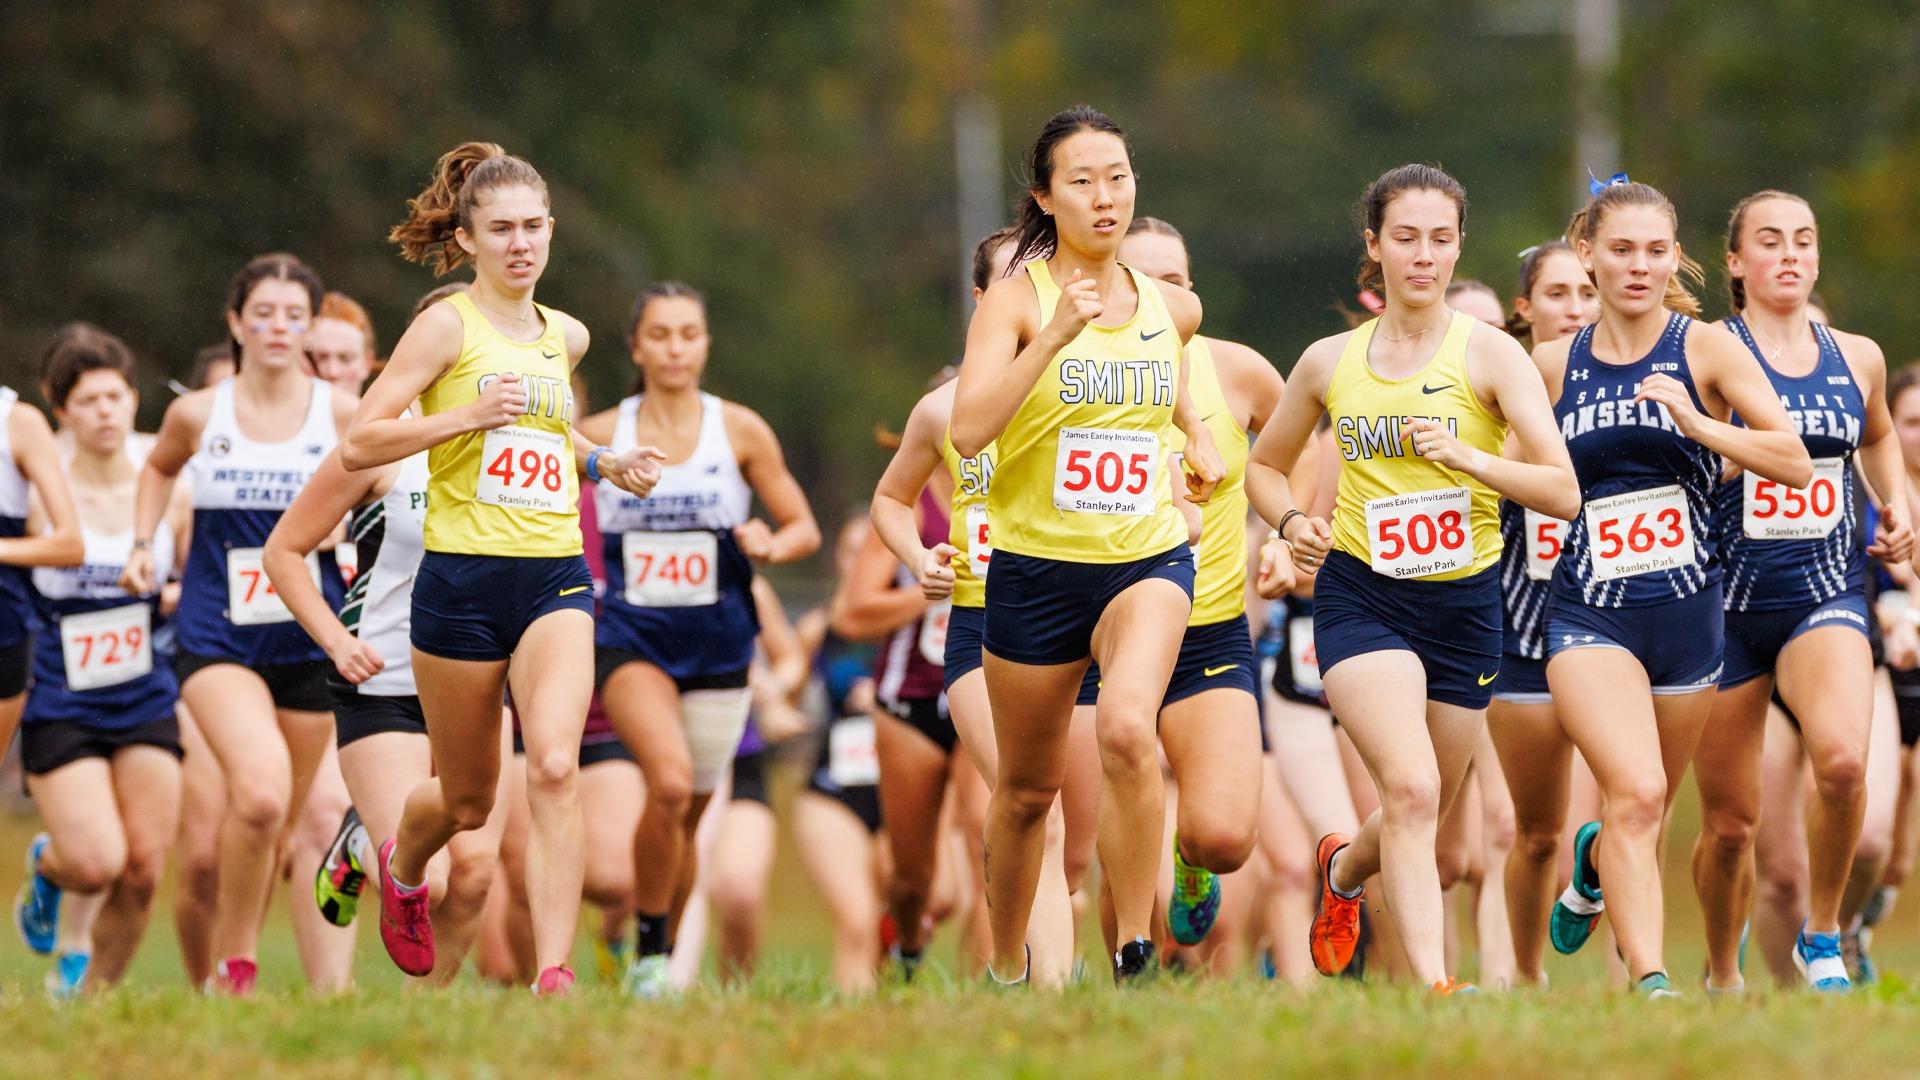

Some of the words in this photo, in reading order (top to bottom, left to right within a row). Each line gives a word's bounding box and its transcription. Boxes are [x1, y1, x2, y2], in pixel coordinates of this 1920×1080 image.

[477, 372, 574, 425] ITH
[1059, 359, 1174, 407] SMITH
[1576, 383, 1642, 405] SAIN
[1780, 393, 1846, 409] AINT
[1065, 431, 1089, 440] James
[1090, 432, 1114, 441] Earley
[1114, 433, 1154, 442] Invitational
[1786, 409, 1861, 449] SELM
[487, 447, 562, 492] 498
[1062, 449, 1149, 495] 505
[498, 494, 532, 507] Stanley
[533, 498, 552, 507] Park
[1075, 500, 1114, 512] Stanley
[1115, 502, 1136, 512] Park
[1371, 501, 1394, 510] James
[1395, 497, 1419, 507] Earley
[1420, 490, 1465, 502] Invitational
[1591, 502, 1612, 512] James
[1612, 497, 1637, 507] Earley
[1637, 489, 1680, 502] Invitational
[1752, 478, 1836, 519] 550
[1378, 509, 1465, 561] 508
[1537, 522, 1561, 561] 5
[1599, 507, 1685, 559] 563
[1765, 527, 1800, 537] Stanley
[1802, 526, 1823, 535] Park
[633, 553, 708, 587] 740
[1395, 564, 1433, 577] Stanley
[1434, 559, 1456, 570] Park
[1615, 562, 1651, 574] Stanley
[1652, 556, 1675, 568] Park
[72, 626, 143, 669] 729
